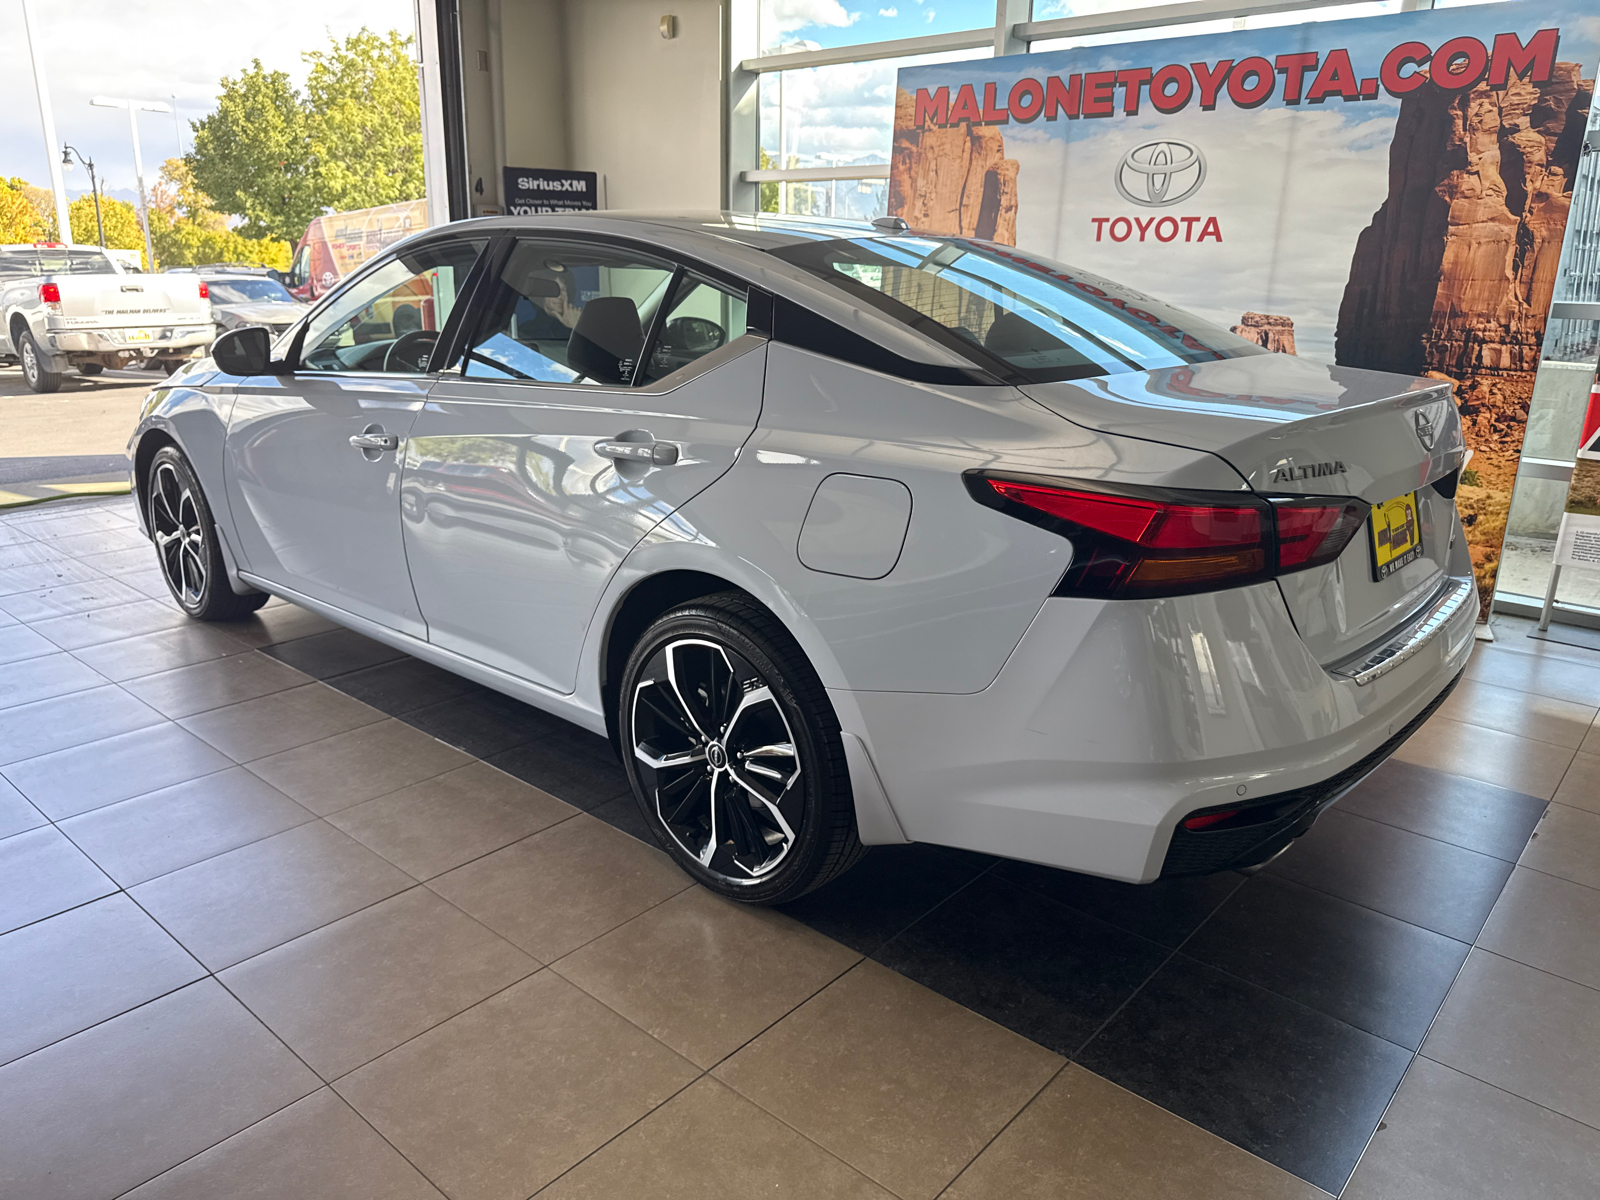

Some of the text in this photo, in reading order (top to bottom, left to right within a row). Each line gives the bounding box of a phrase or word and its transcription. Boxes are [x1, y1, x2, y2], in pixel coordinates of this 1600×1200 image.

[914, 28, 1560, 131] MALONETOYOTA.COM
[475, 177, 484, 196] 4
[517, 177, 587, 192] SiriusXM
[1091, 216, 1223, 243] TOYOTA
[1273, 461, 1347, 483] ALTIMA
